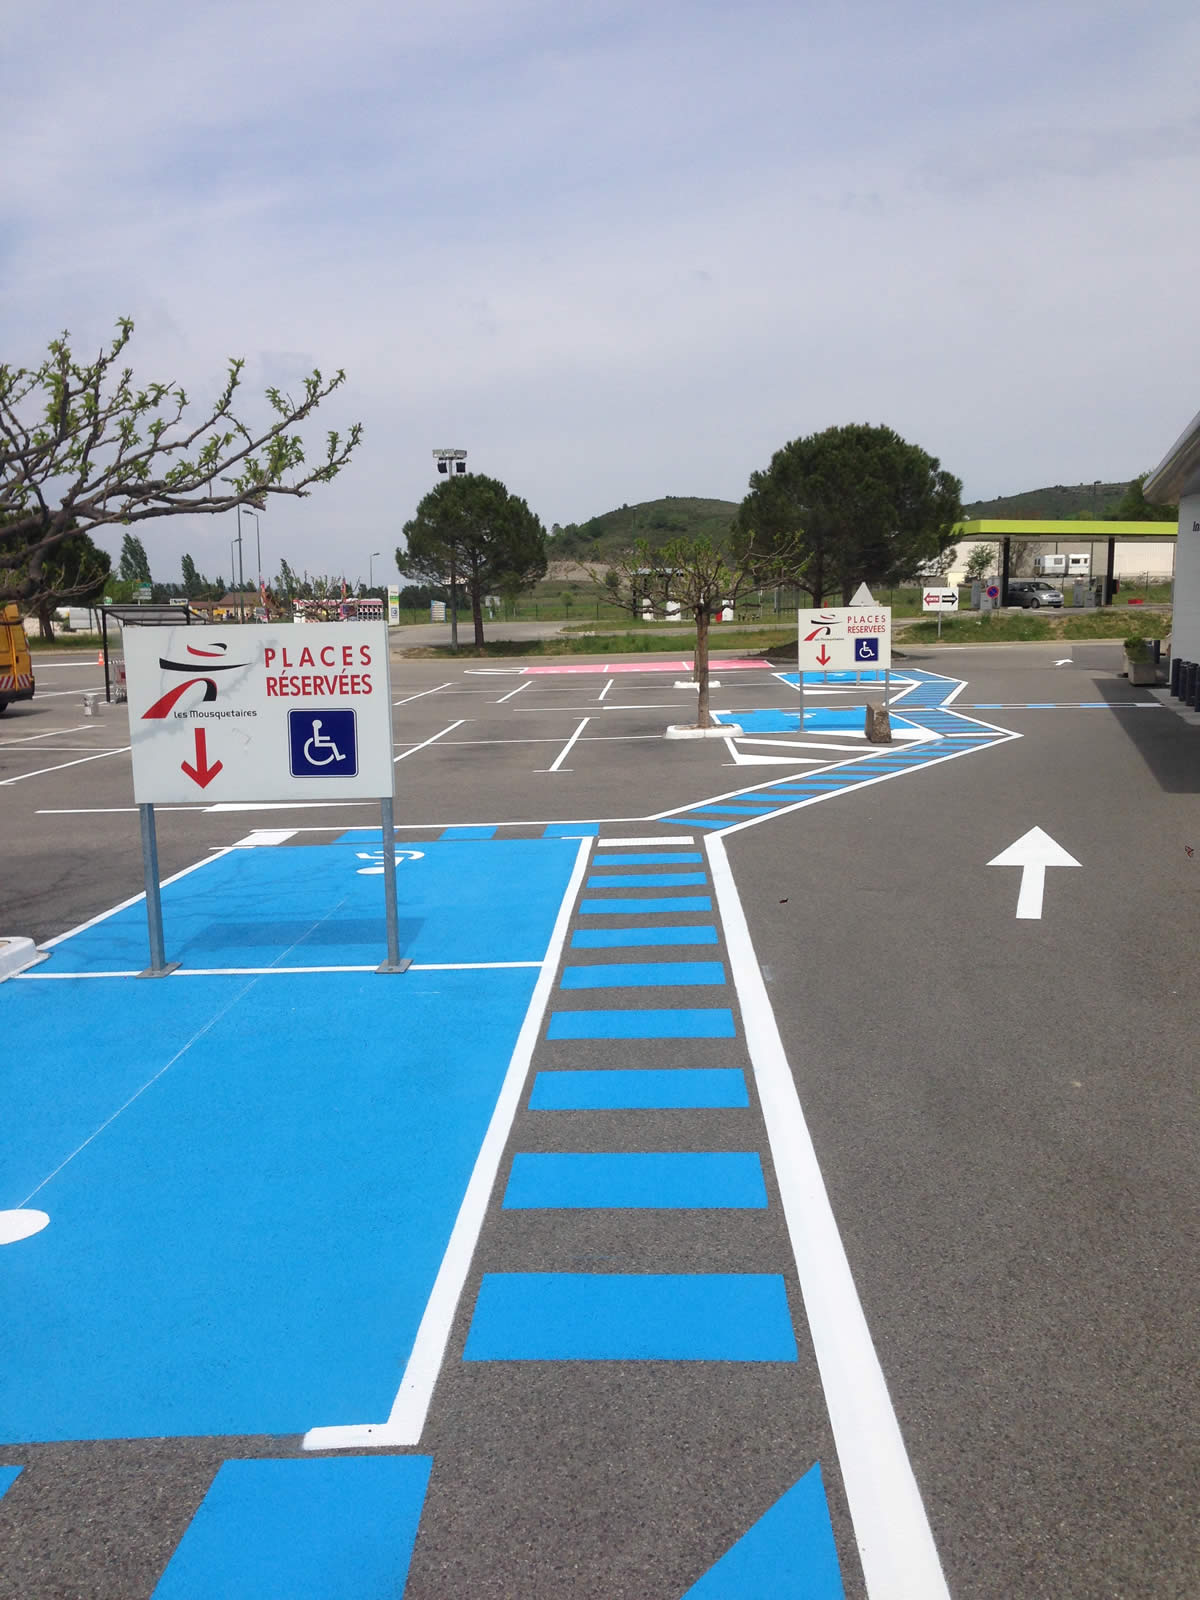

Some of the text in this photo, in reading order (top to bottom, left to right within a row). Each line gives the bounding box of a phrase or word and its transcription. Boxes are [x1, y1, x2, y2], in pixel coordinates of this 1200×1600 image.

[847, 615, 886, 624] PLACES
[264, 645, 371, 668] PLACES
[266, 669, 372, 696] RÉSERVÉES
[190, 709, 257, 719] Mousquetaires
